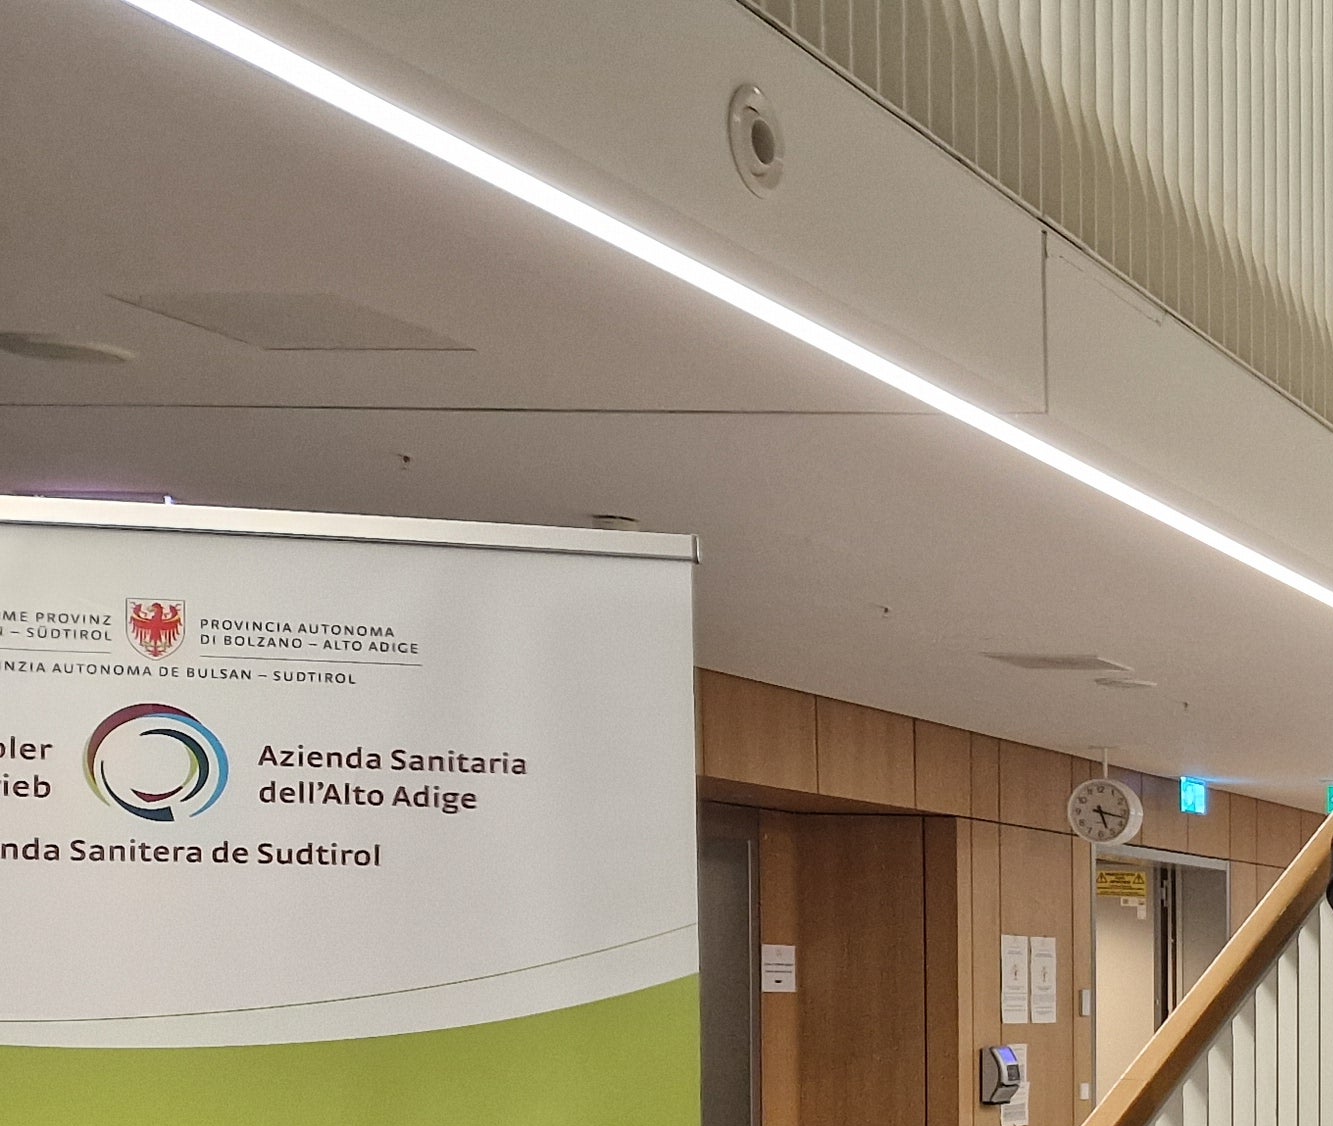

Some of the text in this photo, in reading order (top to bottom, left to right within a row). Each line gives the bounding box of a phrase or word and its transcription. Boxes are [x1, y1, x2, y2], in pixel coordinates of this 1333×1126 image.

[0, 610, 112, 626] ME PROVINZ
[200, 618, 395, 638] PROVINCIA AUTONOMA
[27, 625, 112, 641] SÜDTIROL
[200, 634, 216, 645] DI
[224, 635, 303, 649] BOLZANO
[323, 639, 363, 651] ALTO
[368, 641, 419, 654] ADIGE
[52, 662, 152, 677] AUTONOMA
[159, 666, 179, 678] DE
[187, 667, 252, 680] BULSAN
[273, 670, 357, 684] SUDTIROL
[0, 735, 53, 760] ler
[258, 745, 527, 775] Azienda Sanitaria
[0, 773, 51, 798] ieb
[259, 781, 477, 814] dell’Alto Adige
[1, 837, 381, 867] nda Sanitera de Sudtirol
